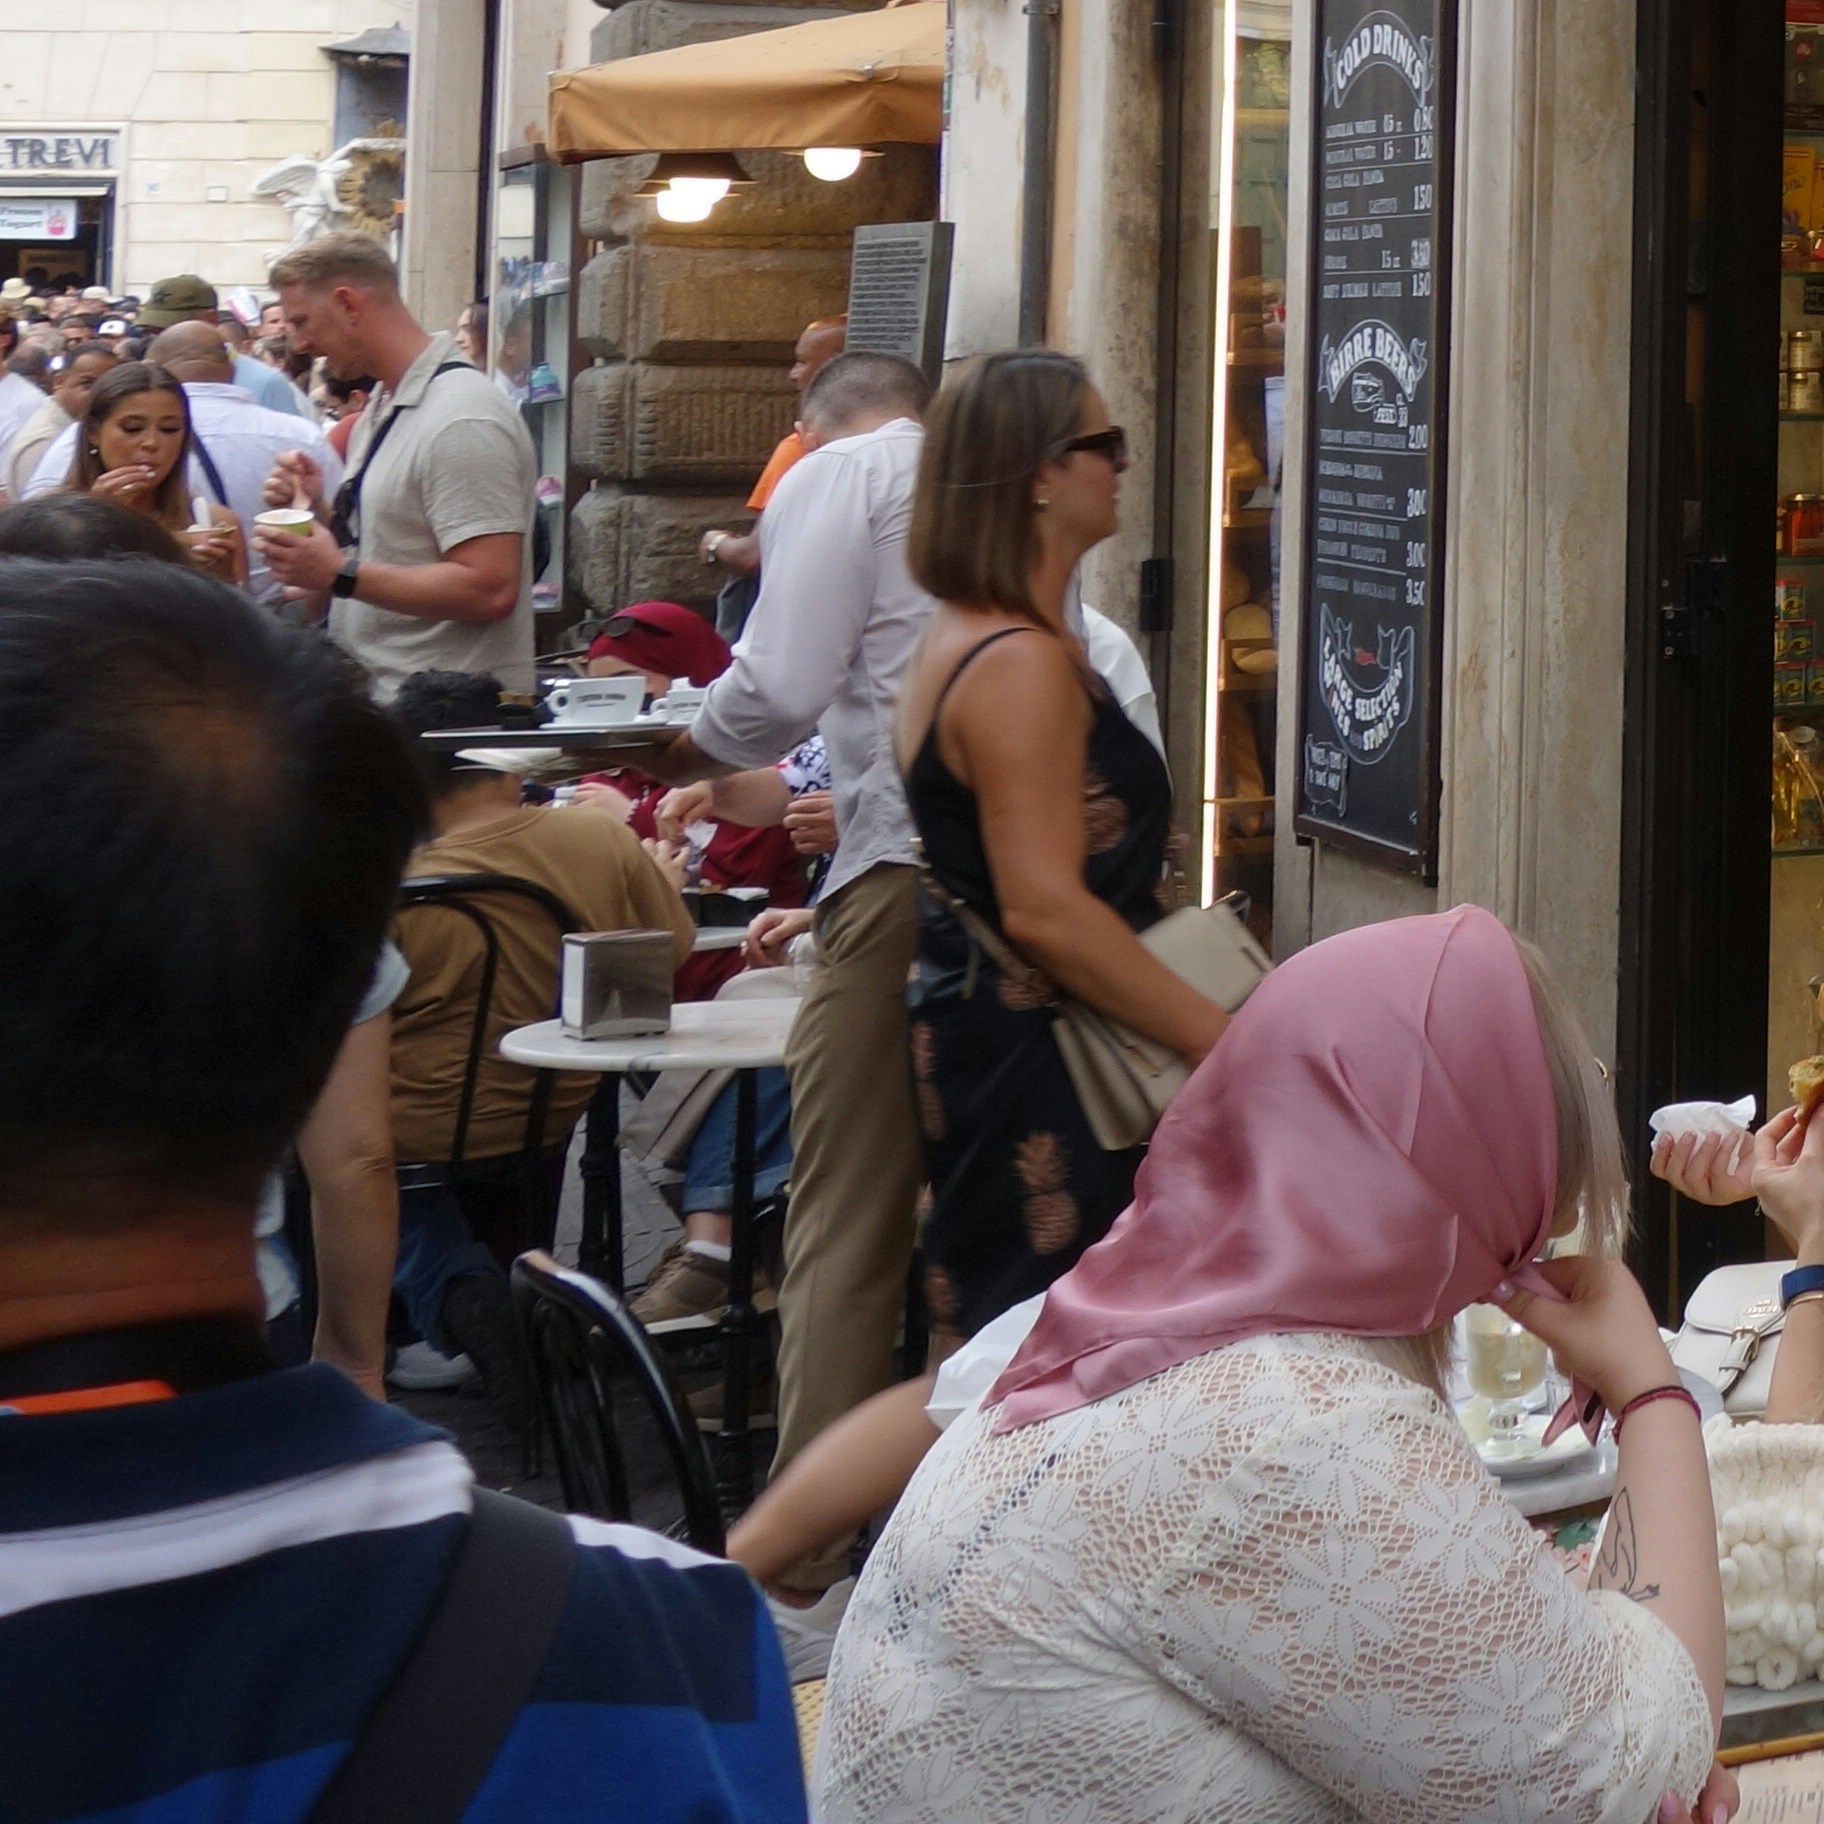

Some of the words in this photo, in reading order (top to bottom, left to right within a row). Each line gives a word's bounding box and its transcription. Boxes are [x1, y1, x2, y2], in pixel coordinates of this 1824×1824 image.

[1337, 27, 1371, 90] COLD
[1372, 24, 1423, 90] DRINKS
[4, 138, 113, 169] TREVI
[1329, 327, 1373, 388] BIRRE
[1374, 327, 1416, 398] BEERS
